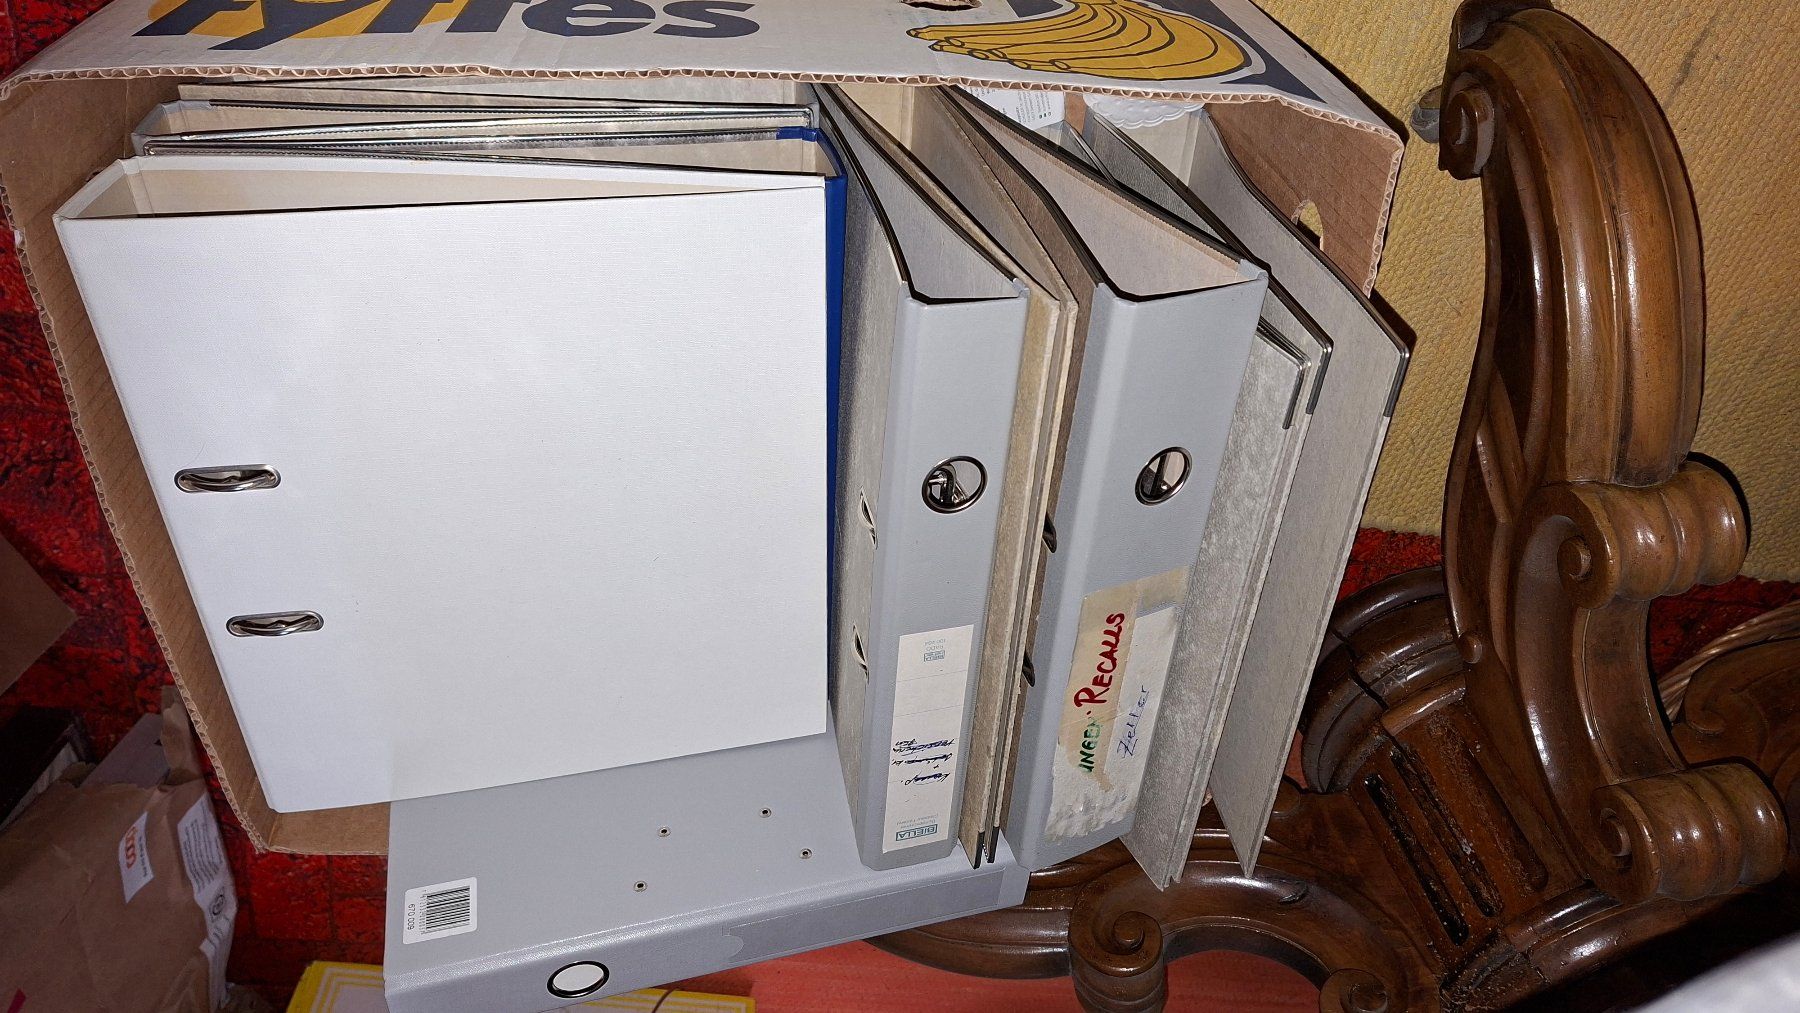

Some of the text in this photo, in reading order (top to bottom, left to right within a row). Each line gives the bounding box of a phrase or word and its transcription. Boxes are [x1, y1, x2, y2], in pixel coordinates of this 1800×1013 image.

[1073, 612, 1126, 708] RECALLS
[897, 825, 937, 841] BIELLA
[407, 903, 416, 931] 670 009
